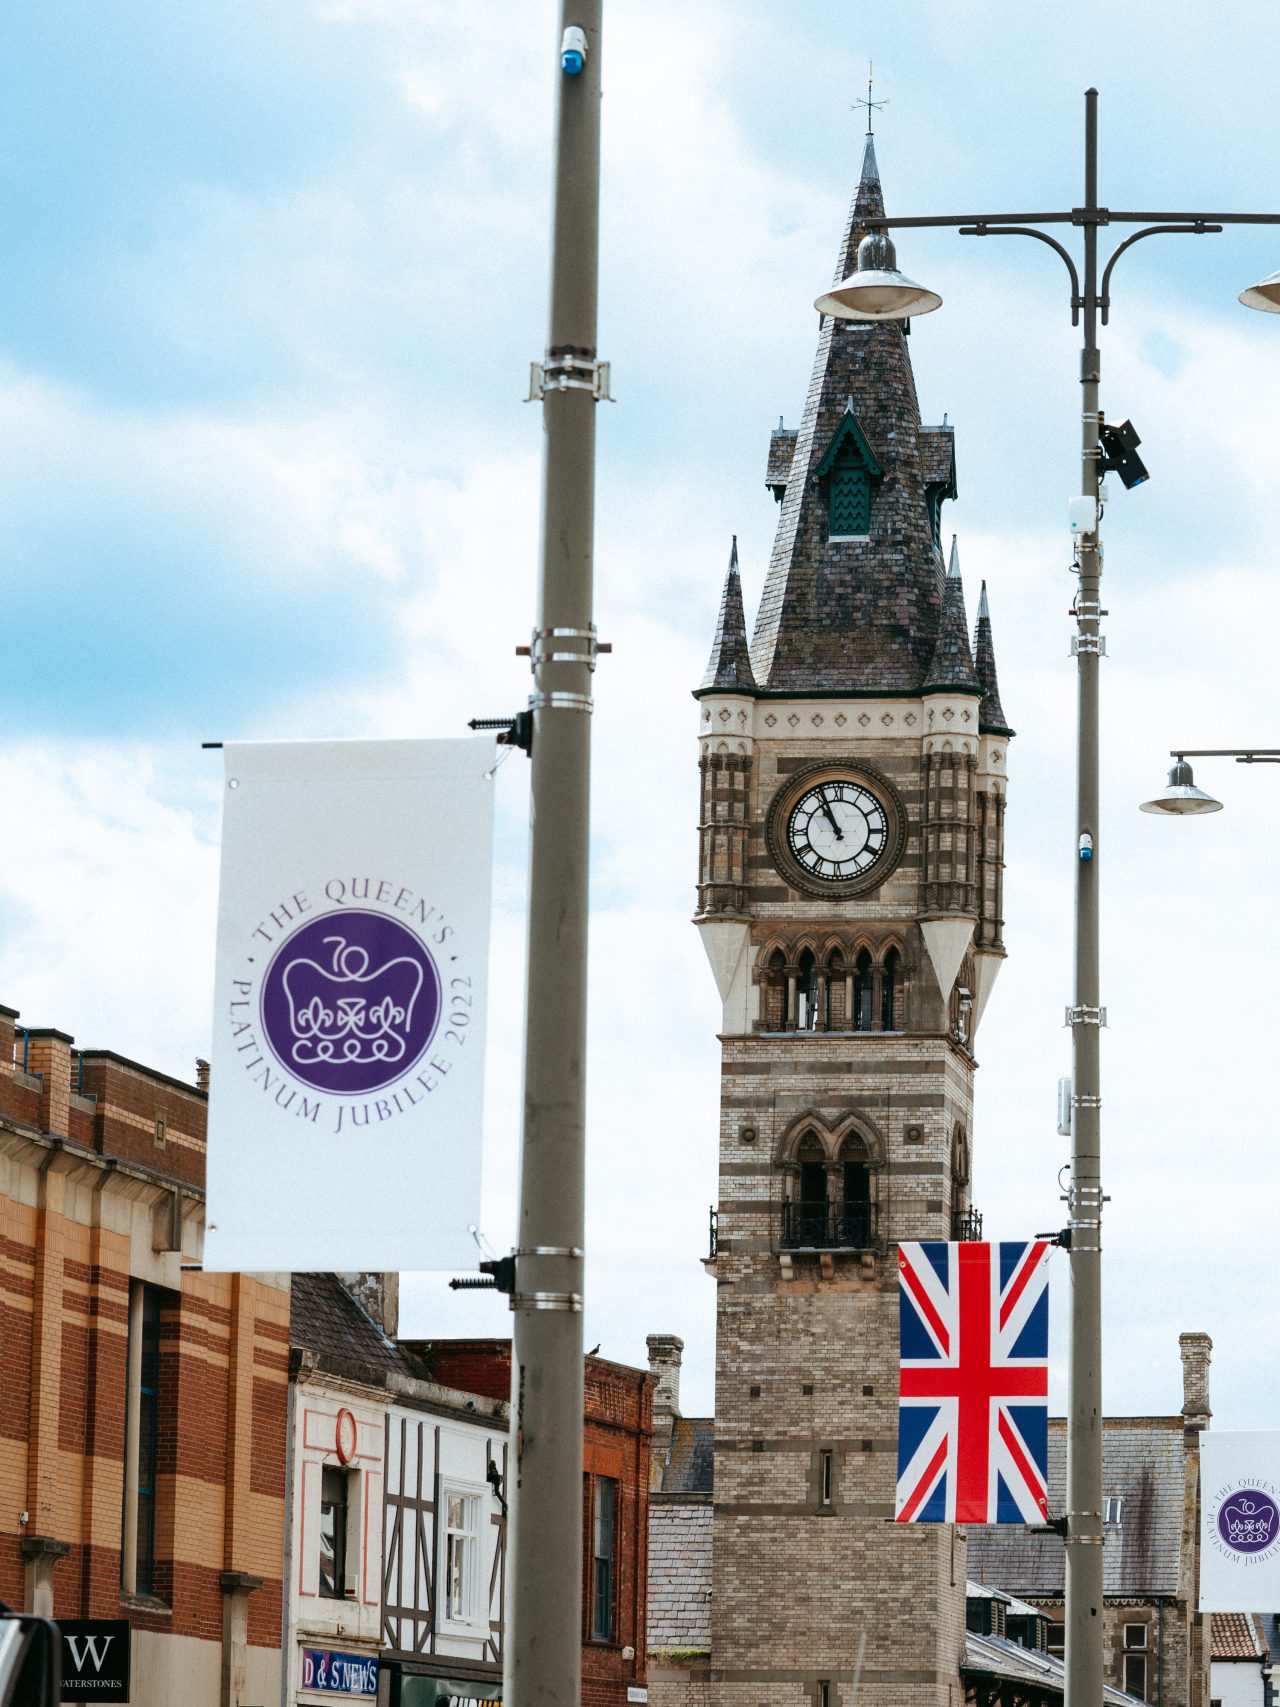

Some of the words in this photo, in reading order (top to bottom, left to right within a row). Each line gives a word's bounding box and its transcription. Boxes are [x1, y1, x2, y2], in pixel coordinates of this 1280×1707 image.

[252, 889, 313, 945] THE
[325, 876, 455, 945] QUEEN'S
[229, 981, 321, 1124] PLATINUM
[333, 1054, 453, 1134] JUBILEE
[445, 976, 472, 1046] 2022
[1214, 1484, 1234, 1501] THE
[1207, 1513, 1240, 1563] PLATINUM
[64, 1635, 115, 1672] W
[304, 1658, 314, 1686] D
[317, 1659, 327, 1687] &
[331, 1661, 340, 1688] S
